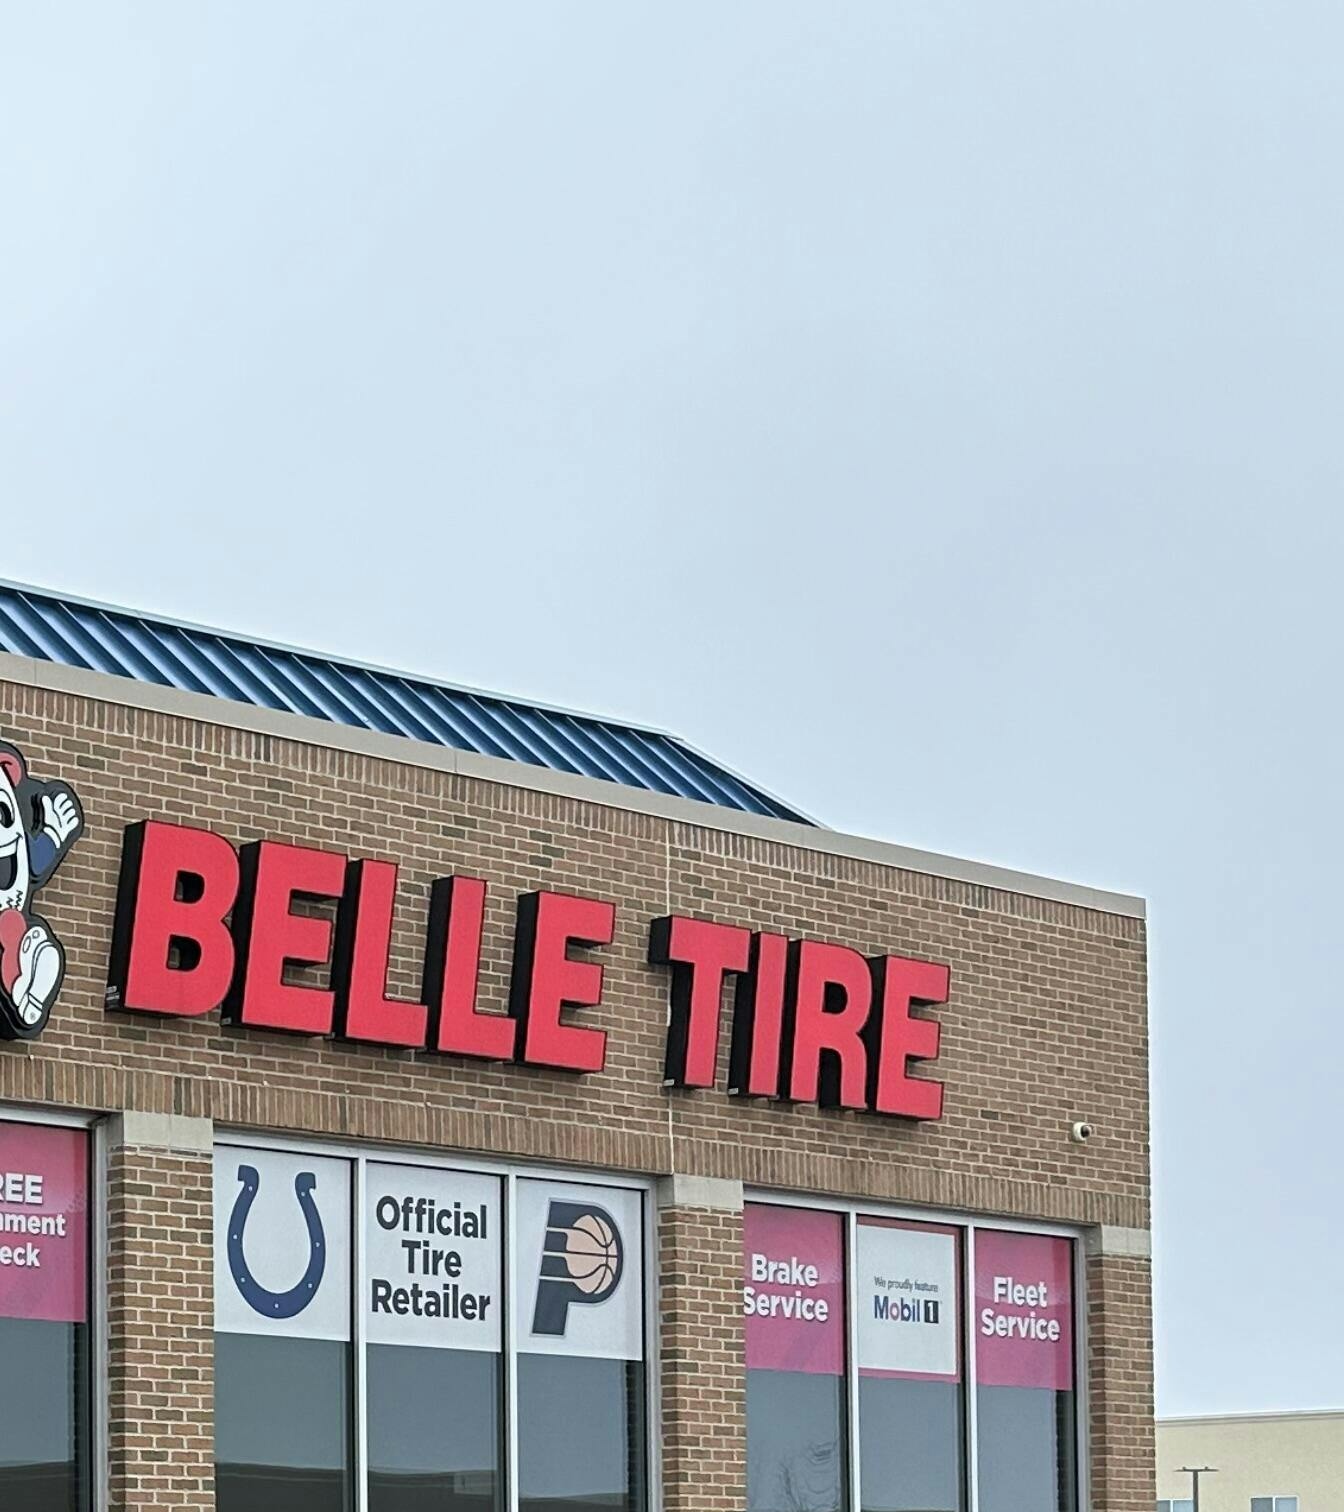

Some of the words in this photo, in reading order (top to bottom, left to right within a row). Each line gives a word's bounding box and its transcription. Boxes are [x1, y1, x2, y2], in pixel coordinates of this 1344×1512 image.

[107, 819, 616, 1074] BELLE
[648, 914, 951, 1121] TIRE
[376, 1196, 487, 1239] Official
[401, 1239, 462, 1278] Tire
[752, 1253, 819, 1287] Brake
[371, 1279, 491, 1321] Retailer
[744, 1286, 829, 1322] Service
[874, 1295, 920, 1322] Mobil
[994, 1276, 1048, 1308] Fleet
[981, 1308, 1060, 1342] Service
